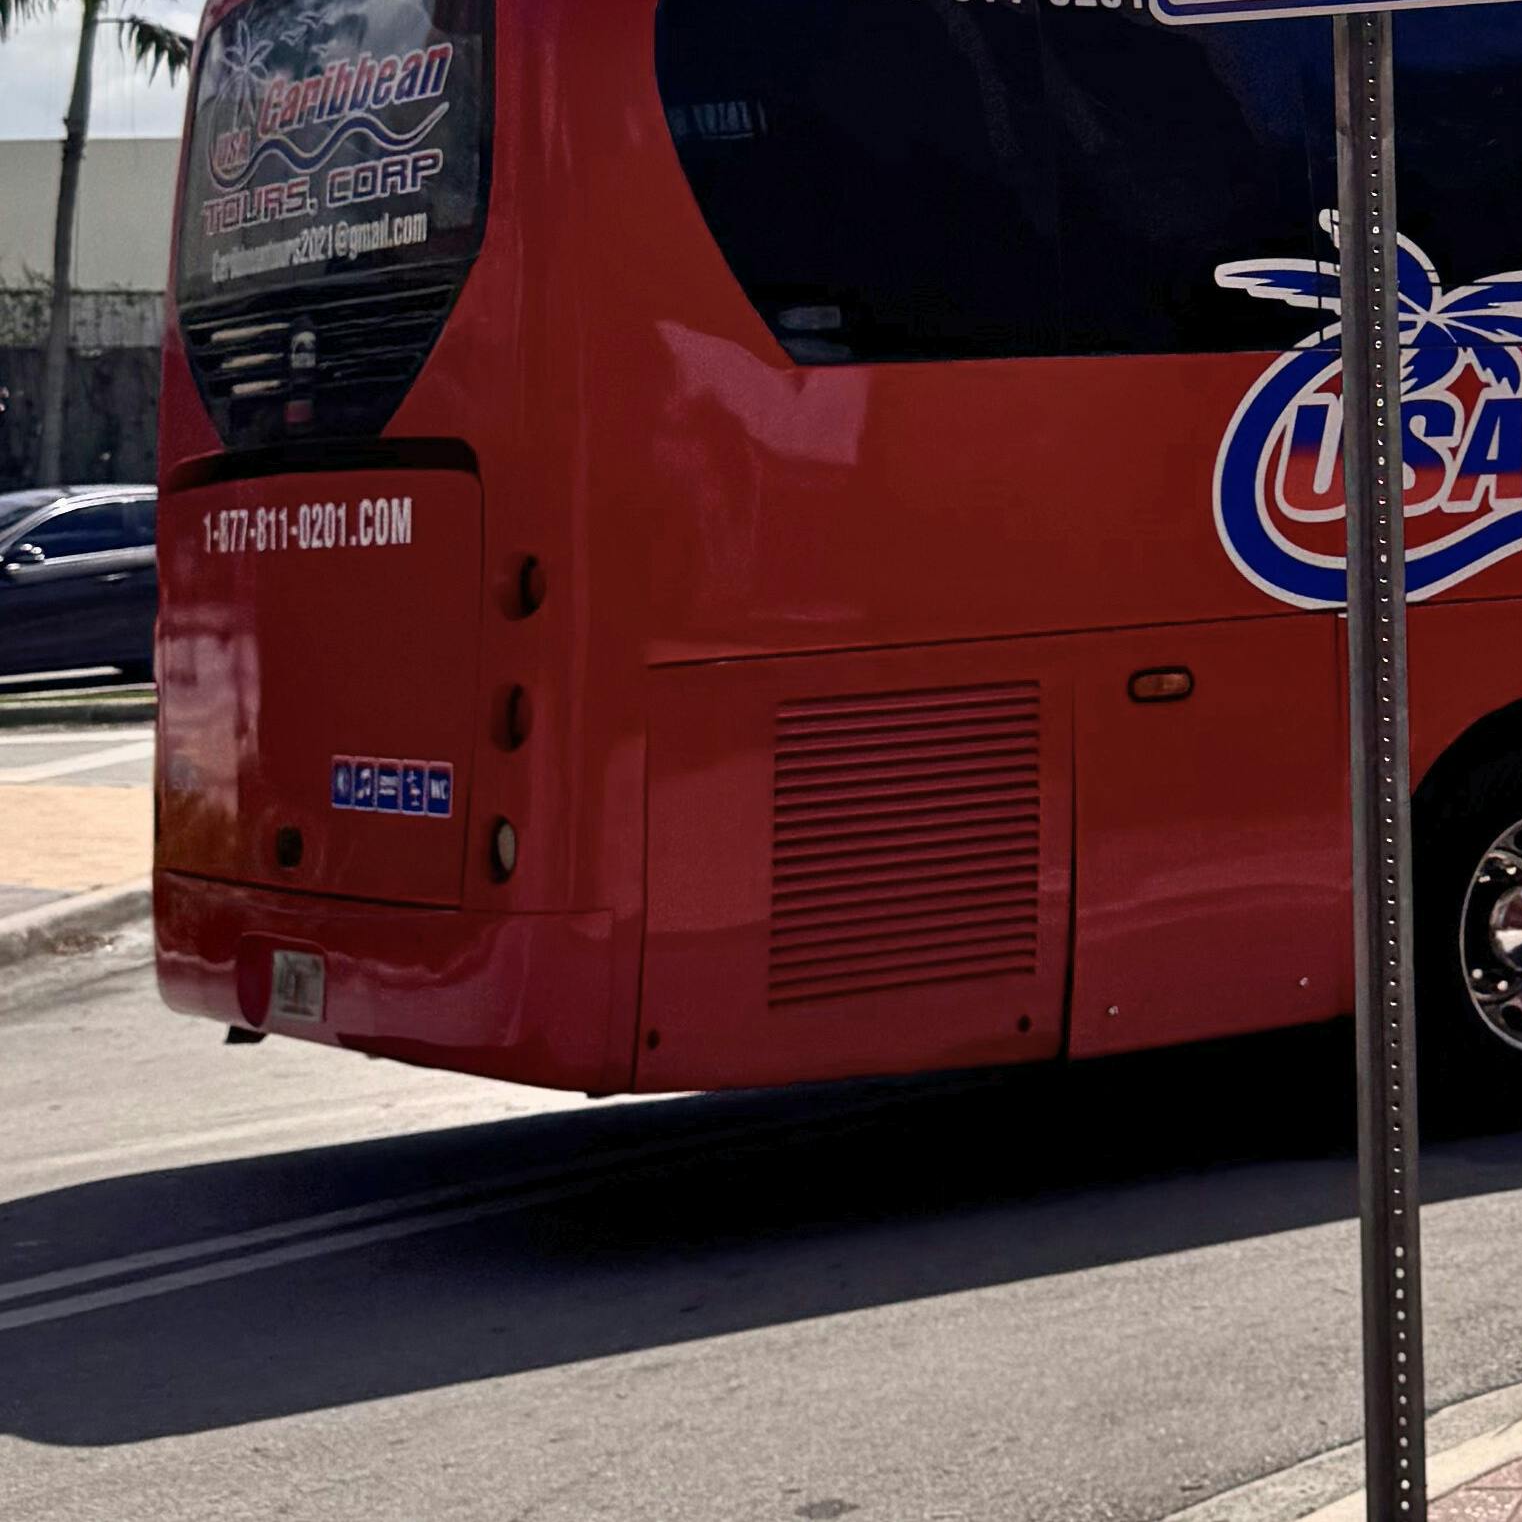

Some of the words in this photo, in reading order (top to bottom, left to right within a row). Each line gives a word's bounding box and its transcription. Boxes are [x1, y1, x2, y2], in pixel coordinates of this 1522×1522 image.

[258, 42, 453, 138] Caribbean
[214, 128, 252, 167] USA
[326, 149, 443, 207] CORP
[203, 496, 413, 554] 1-877-811-0201.COM
